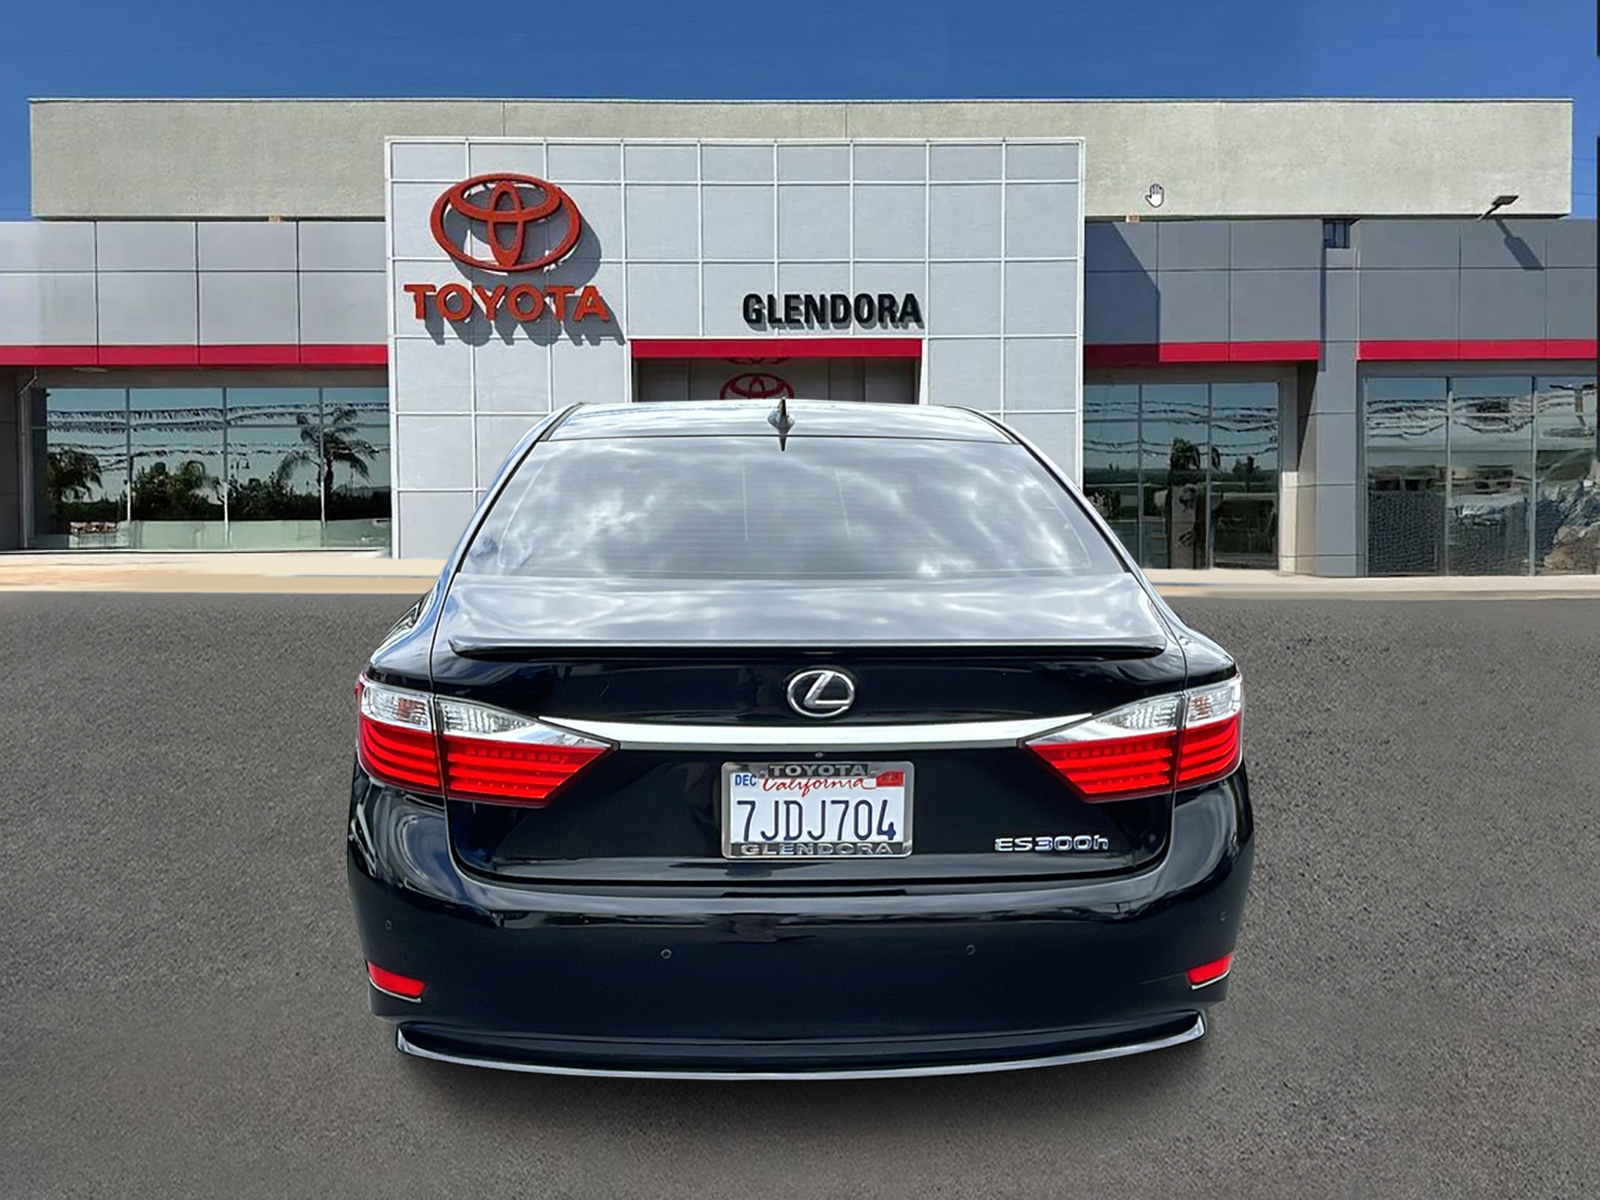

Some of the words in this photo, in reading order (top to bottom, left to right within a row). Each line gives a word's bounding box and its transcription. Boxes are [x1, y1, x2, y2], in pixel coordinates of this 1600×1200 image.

[403, 283, 610, 322] TOYOTA
[743, 293, 922, 325] GLENDORA
[735, 774, 757, 787] DEC
[769, 765, 867, 777] TOYOTA
[762, 777, 877, 797] California
[737, 799, 897, 842] 7JDJ704
[741, 843, 893, 855] GLENDORA
